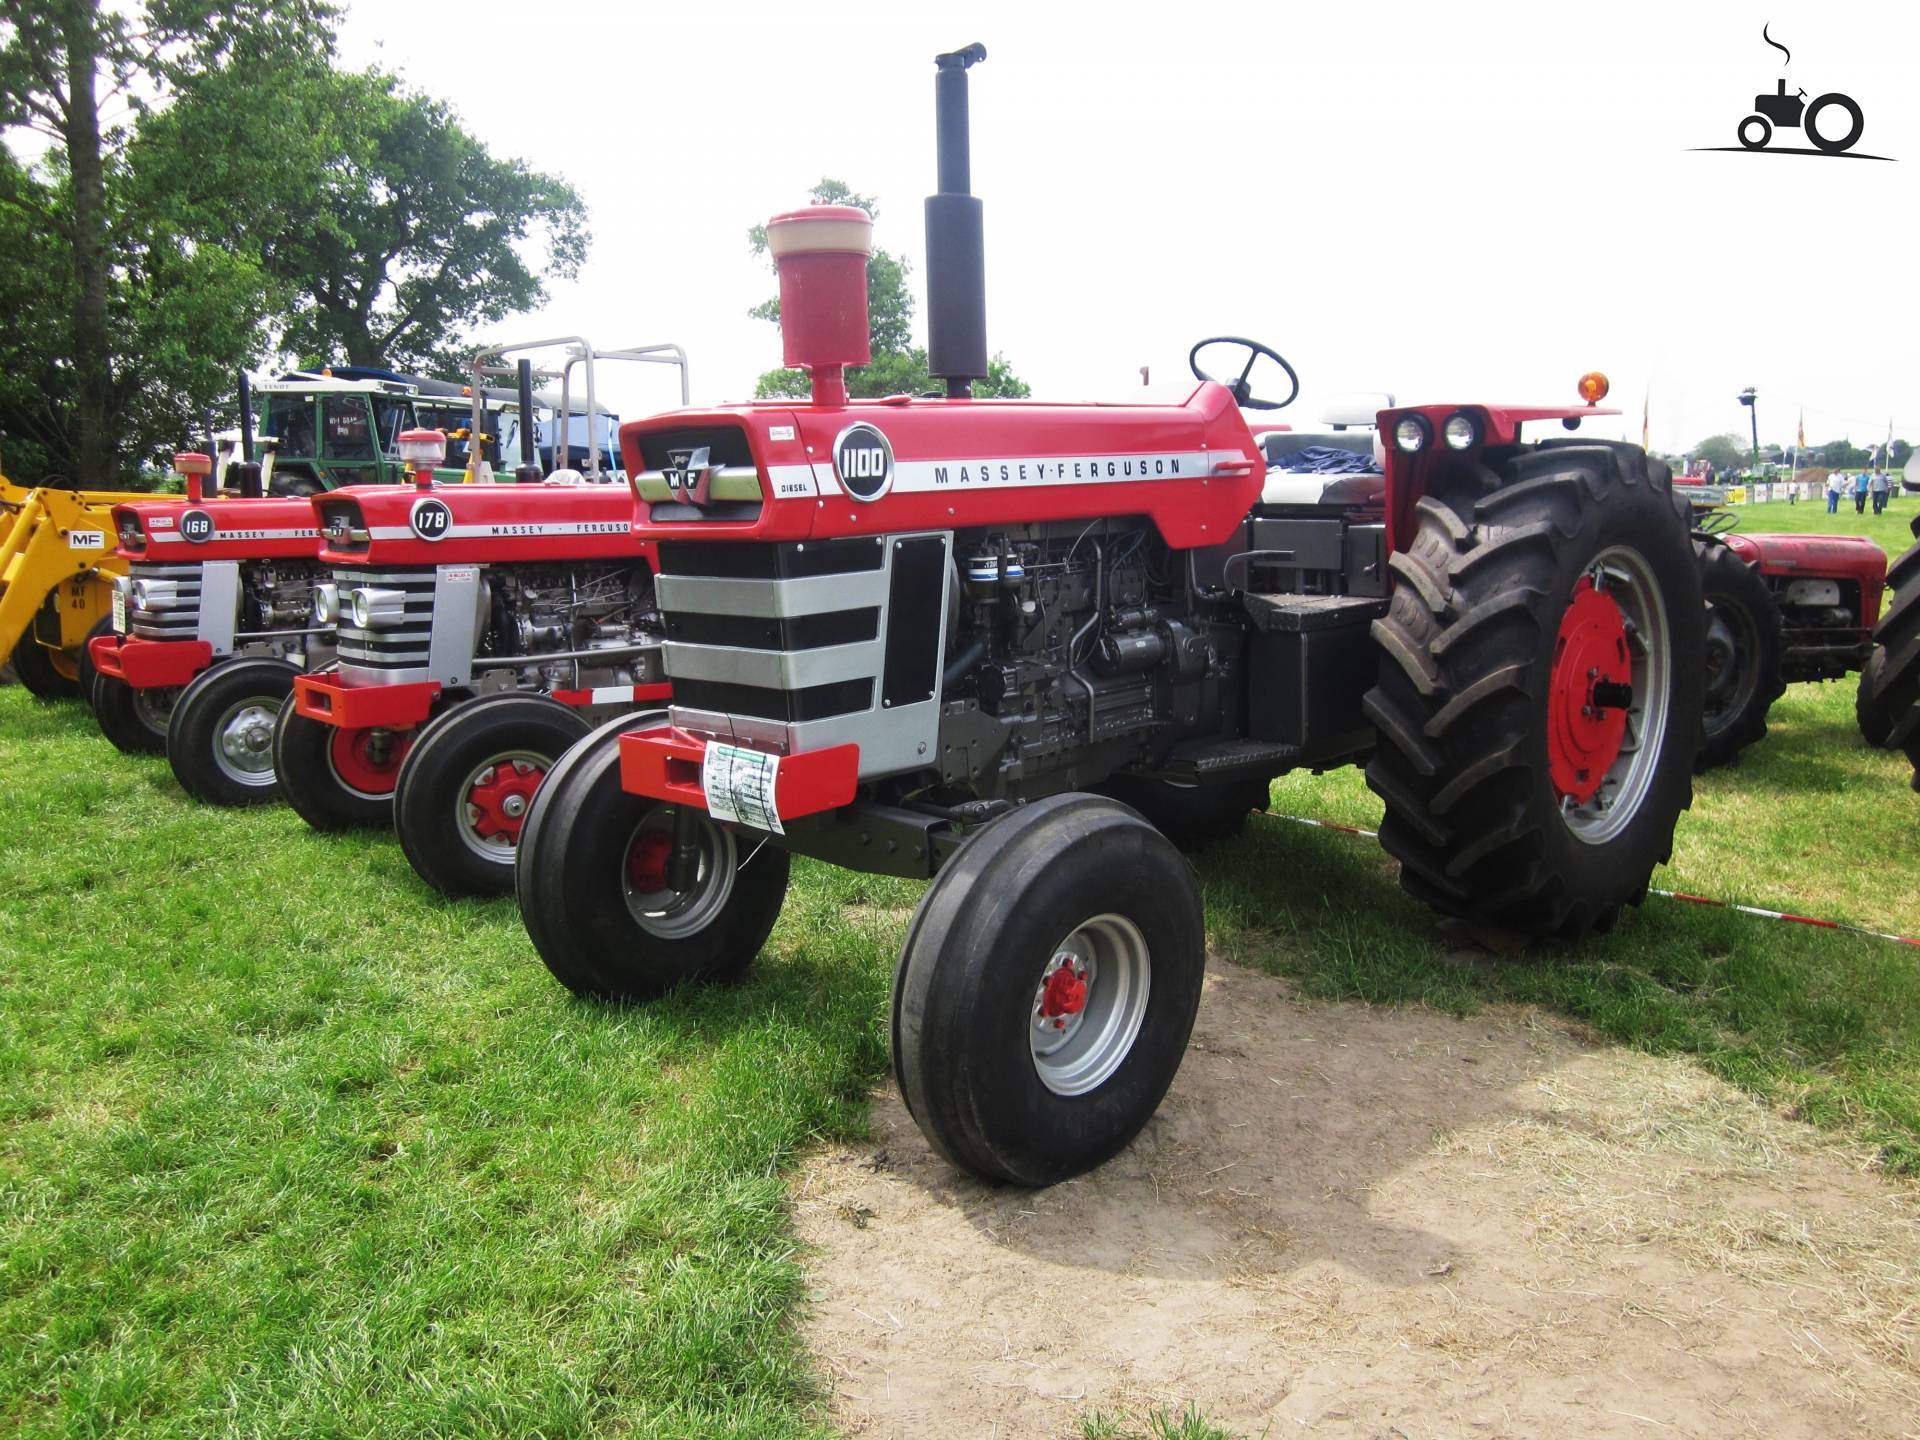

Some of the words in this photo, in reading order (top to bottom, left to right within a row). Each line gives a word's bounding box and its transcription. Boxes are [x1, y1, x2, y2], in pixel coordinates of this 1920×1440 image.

[843, 448, 884, 478] 1100
[781, 484, 808, 493] DIESEL
[418, 512, 445, 529] 178
[186, 520, 209, 534] 168
[491, 525, 544, 536] MASSEY
[576, 523, 629, 533] FERGUSO
[73, 534, 101, 545] MF
[219, 531, 266, 539] MASSEY
[71, 586, 86, 597] MF
[71, 600, 86, 610] 40
